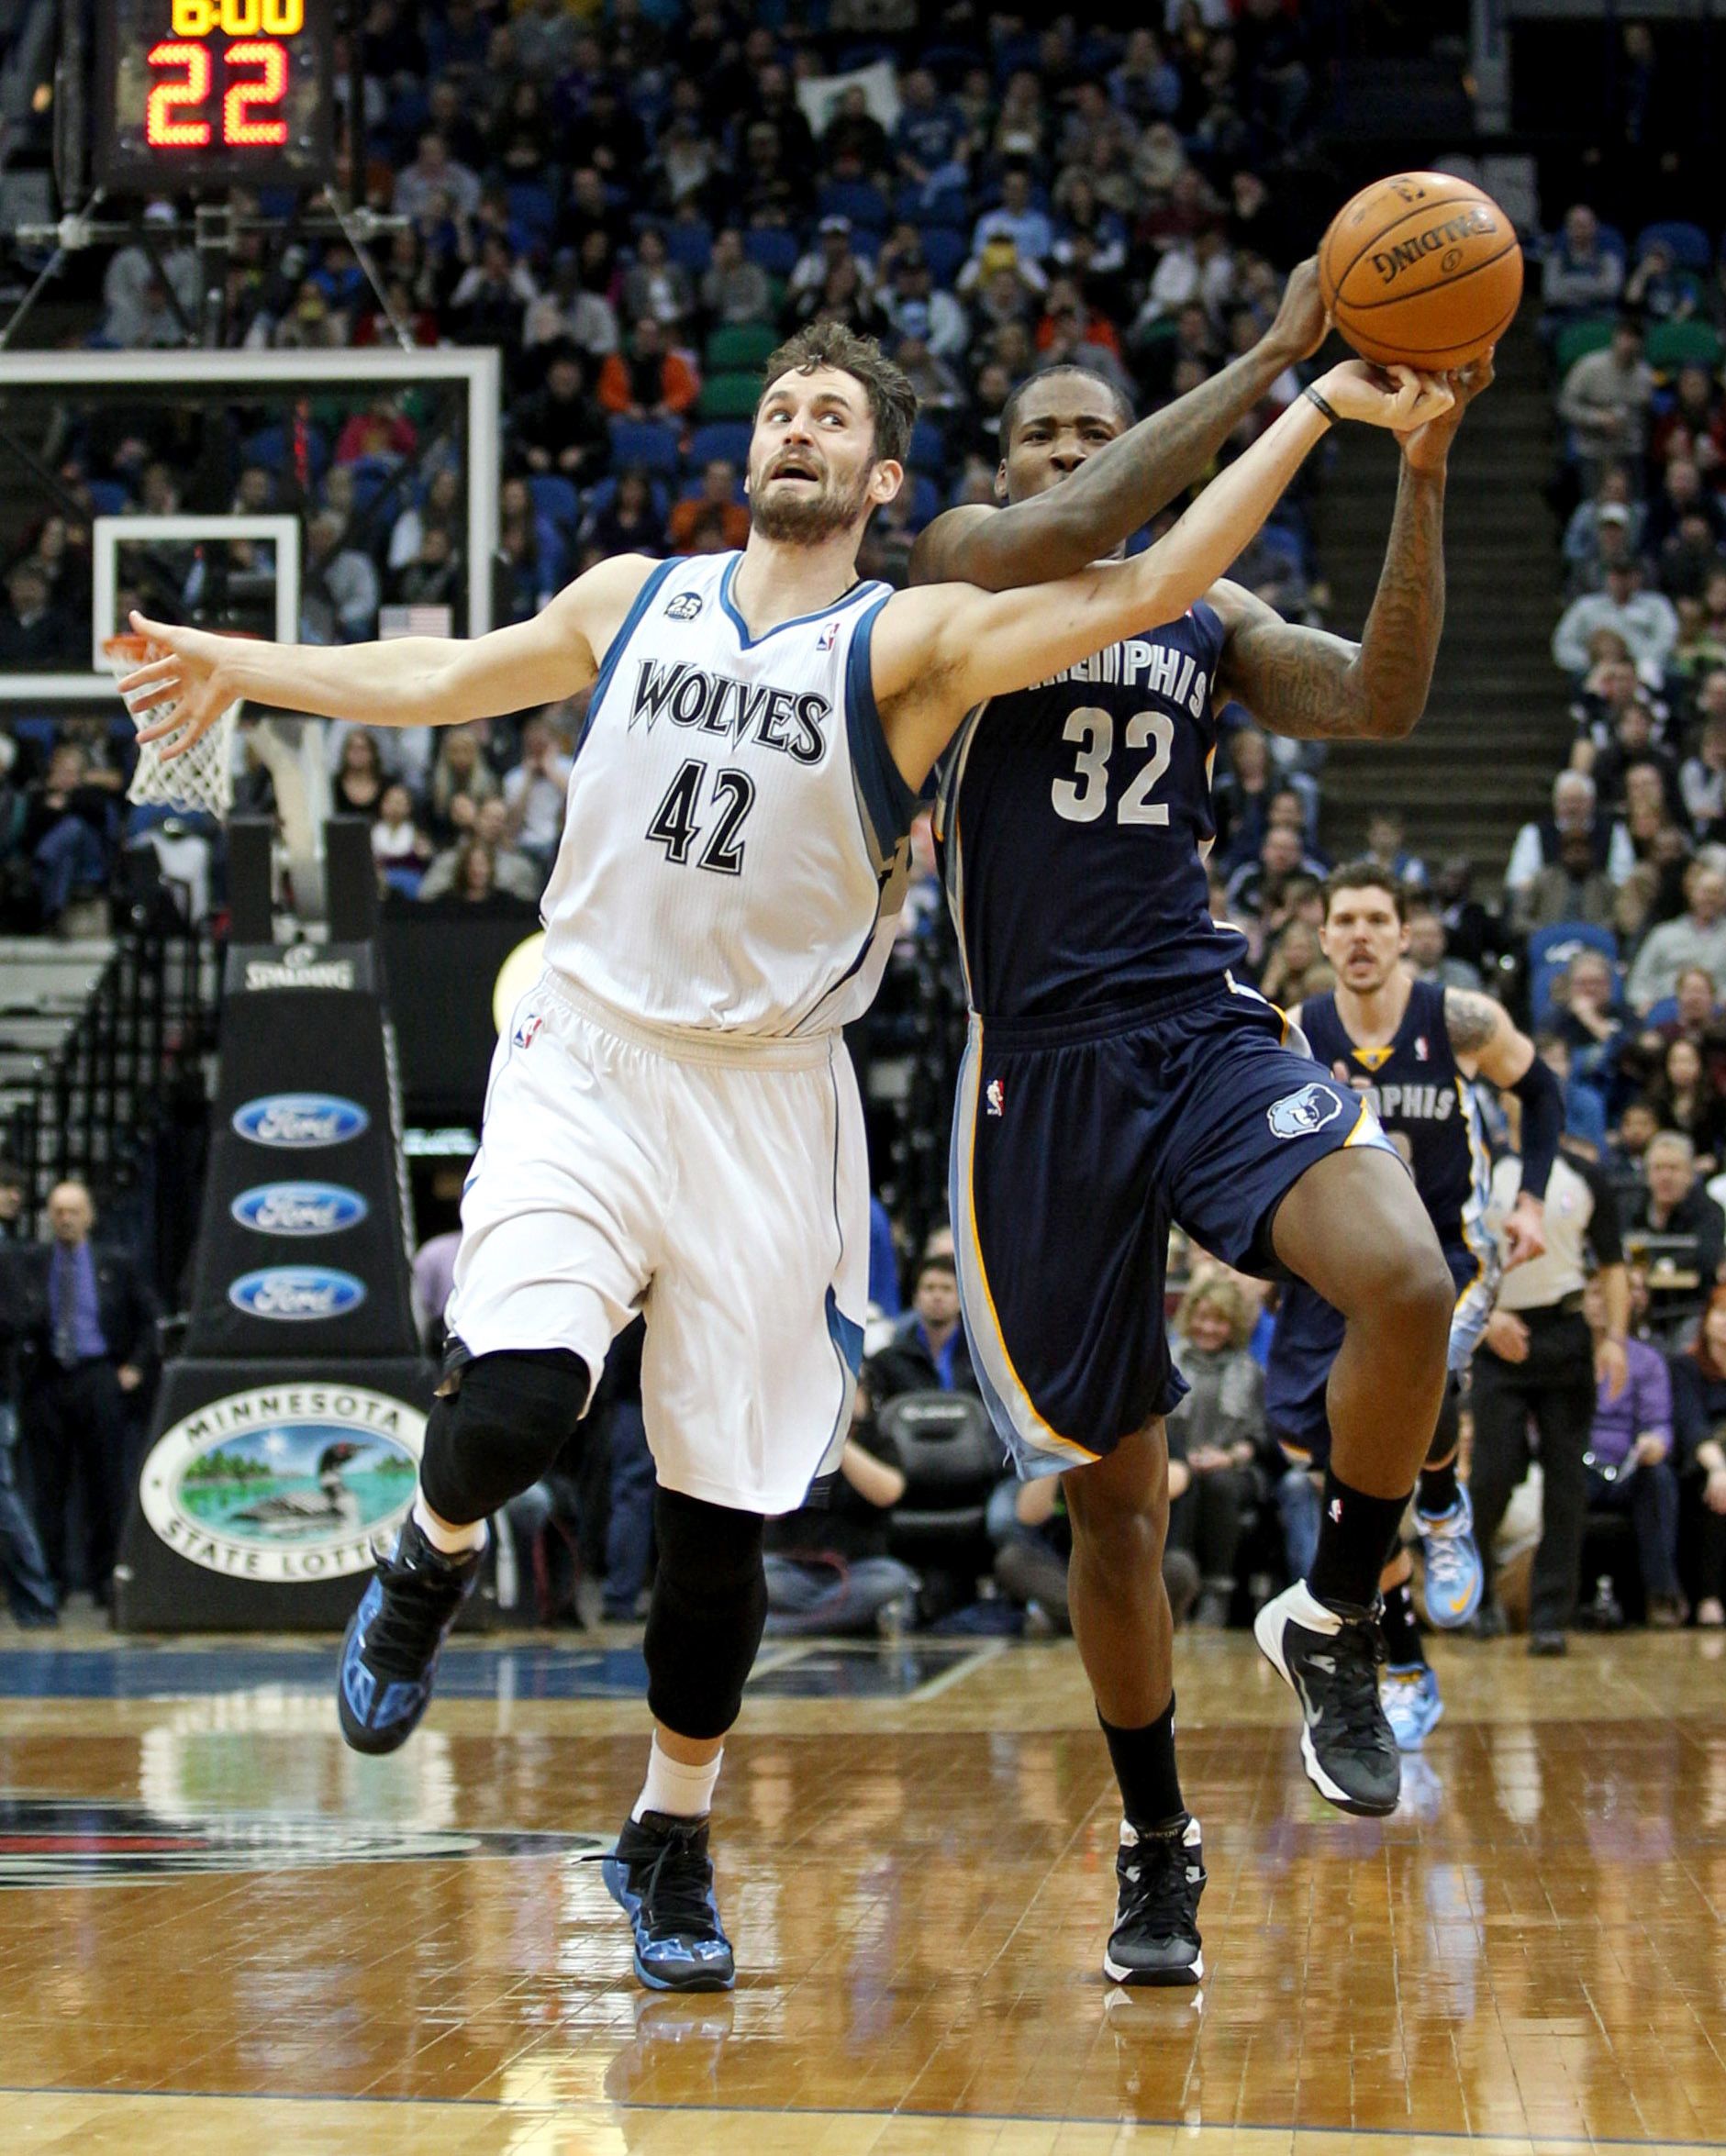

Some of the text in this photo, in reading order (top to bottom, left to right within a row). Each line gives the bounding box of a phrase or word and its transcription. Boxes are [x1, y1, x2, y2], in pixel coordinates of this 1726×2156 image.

[147, 39, 287, 147] 22
[628, 659, 832, 766] WOLVES
[1051, 706, 1175, 827] 32
[645, 758, 756, 876] 42
[257, 1103, 339, 1140] Ford
[255, 1192, 337, 1228] Ford
[252, 1275, 335, 1313] Ford
[186, 1393, 401, 1444] MINNESOTA
[161, 1517, 390, 1575] STATE LOTTE
